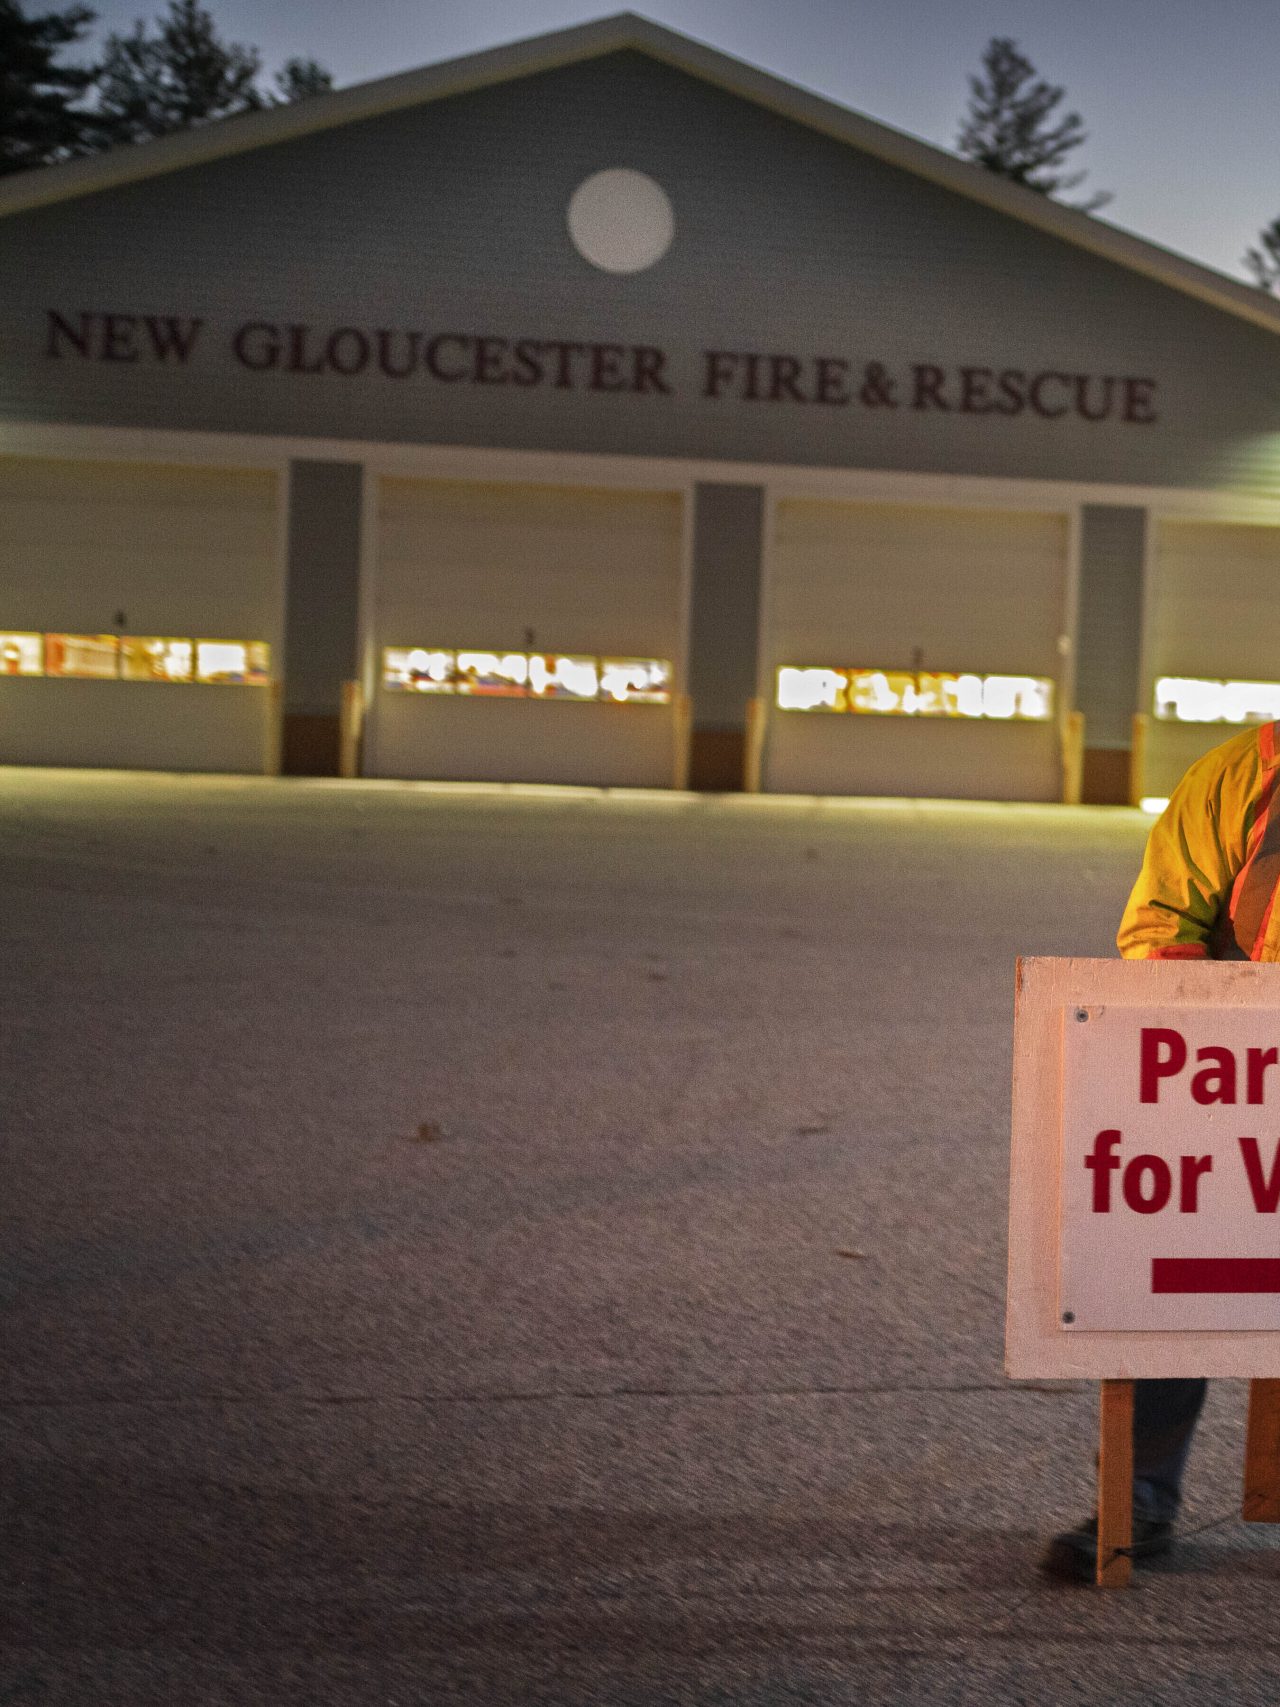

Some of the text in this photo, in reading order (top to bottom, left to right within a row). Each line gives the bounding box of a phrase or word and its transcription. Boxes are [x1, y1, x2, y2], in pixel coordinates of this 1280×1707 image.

[46, 311, 201, 364] NEW
[232, 322, 669, 394] GLOUCESTER
[1084, 1130, 1213, 1214] for
